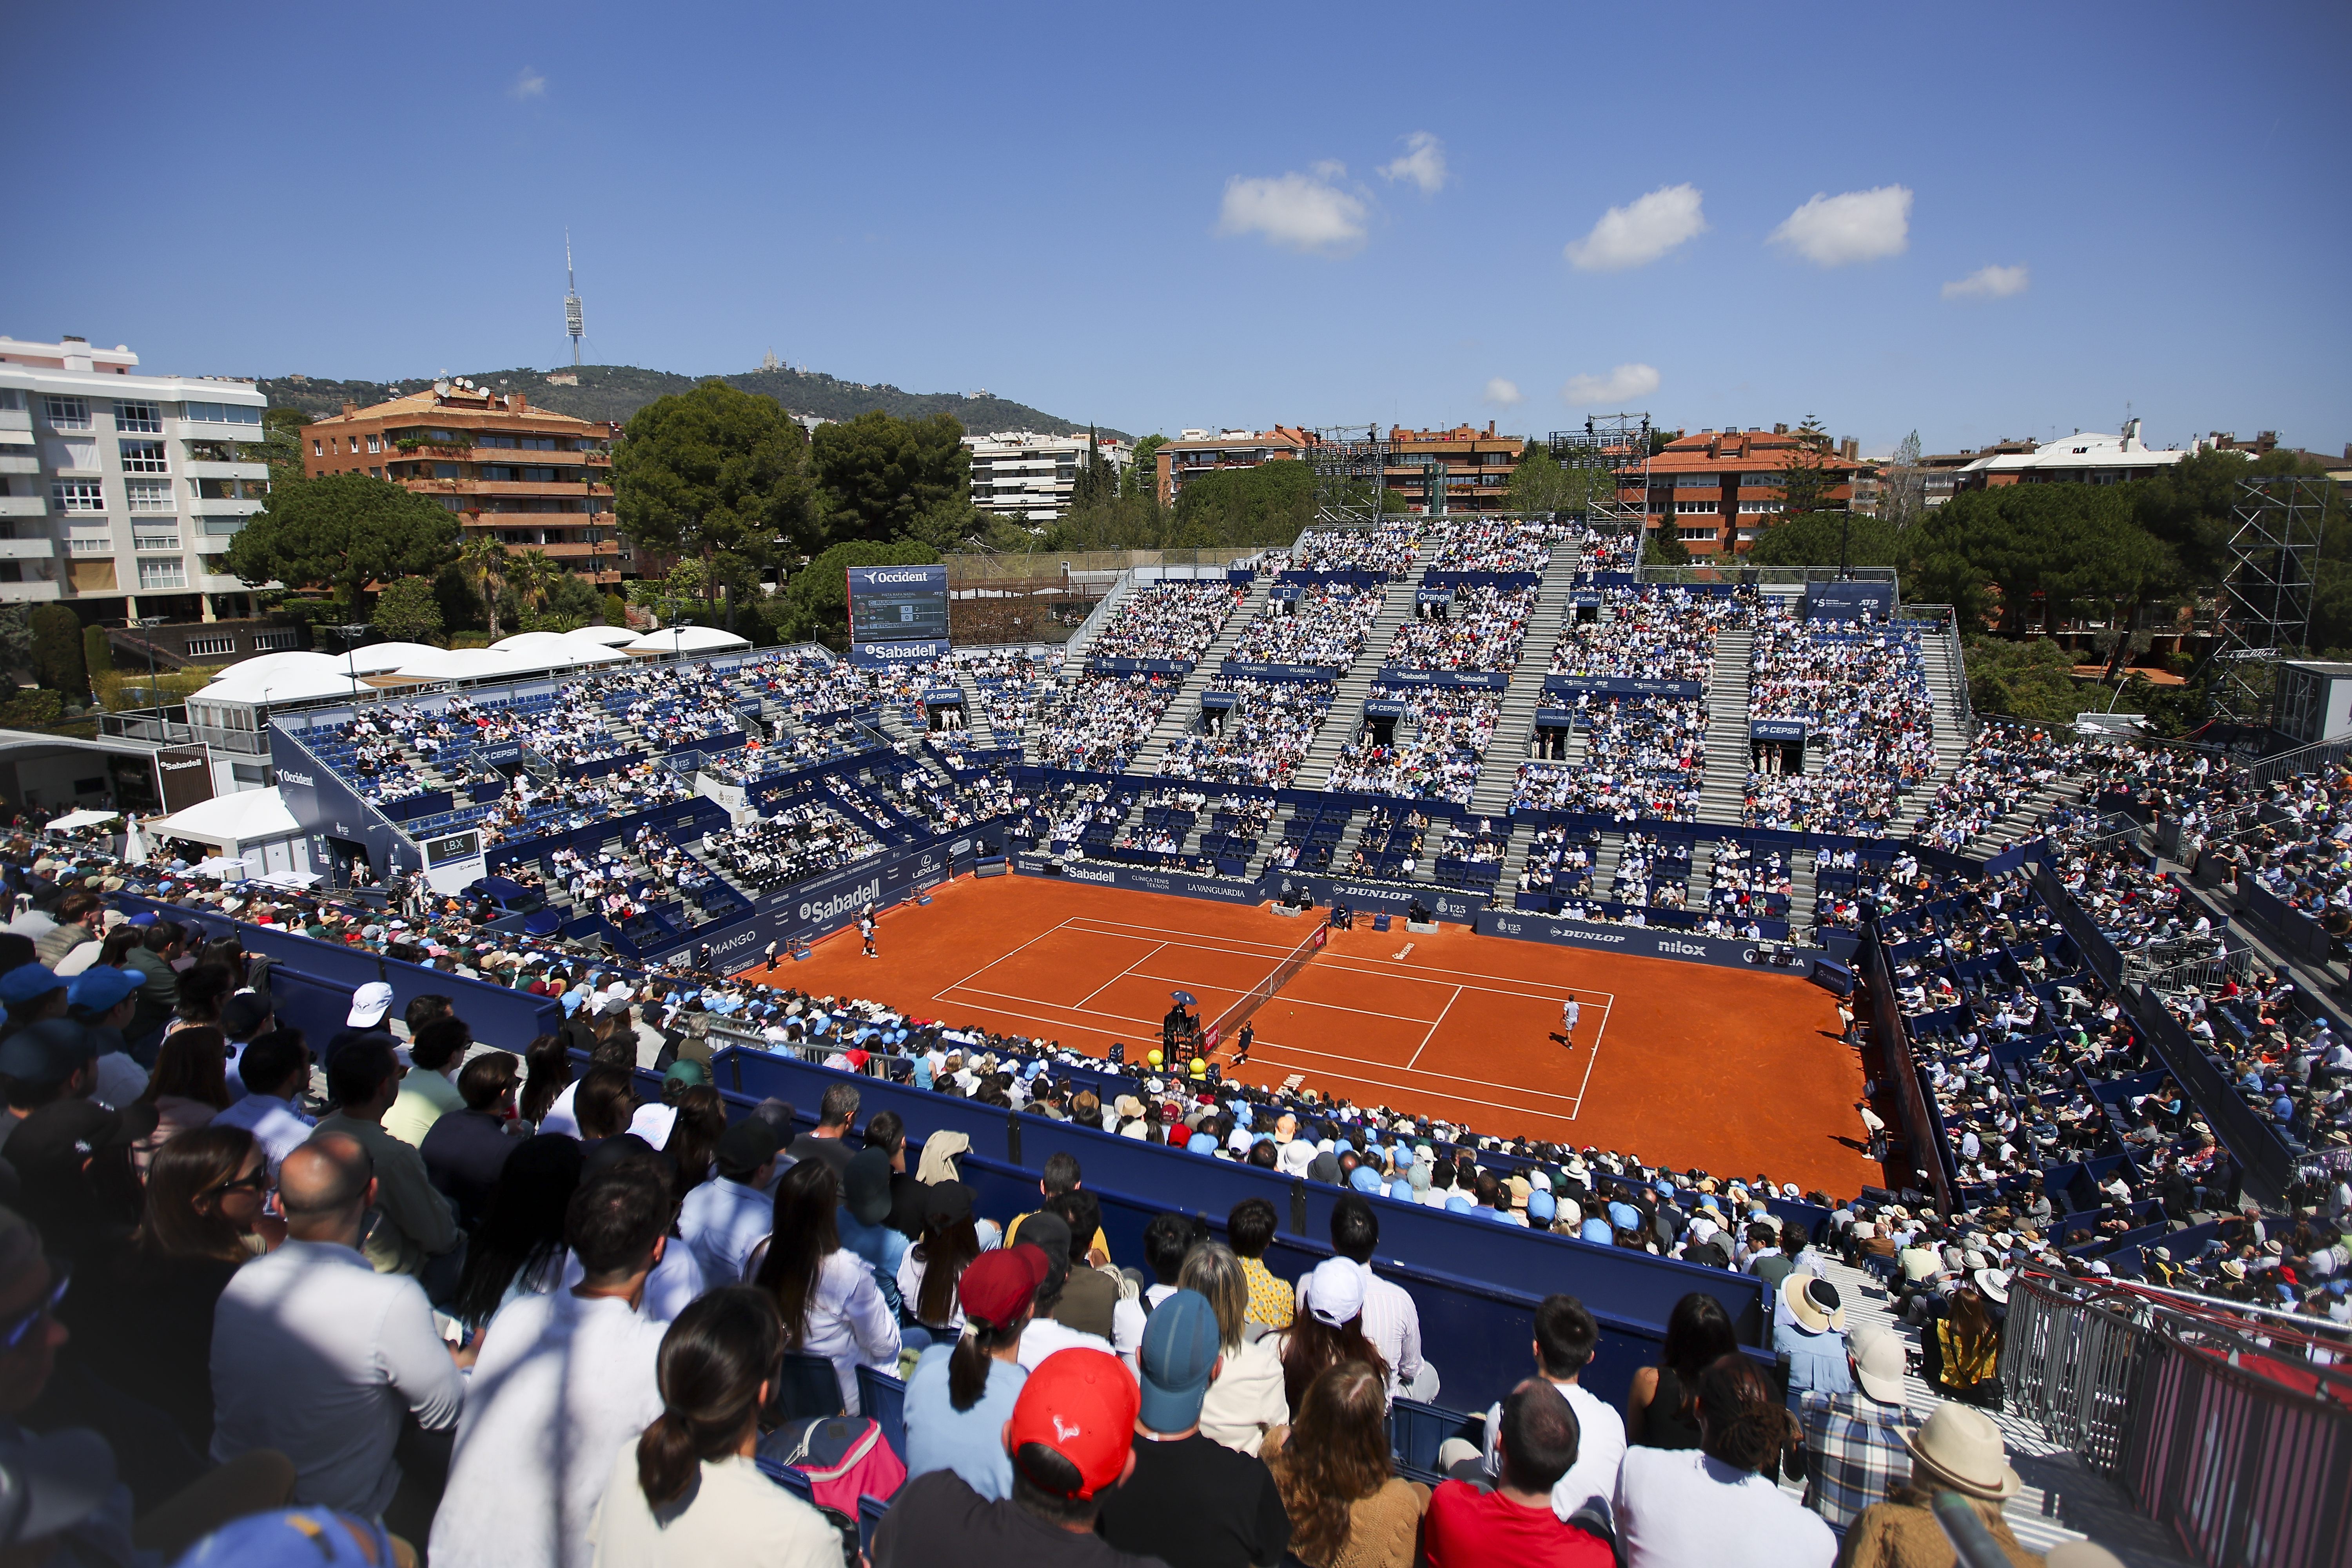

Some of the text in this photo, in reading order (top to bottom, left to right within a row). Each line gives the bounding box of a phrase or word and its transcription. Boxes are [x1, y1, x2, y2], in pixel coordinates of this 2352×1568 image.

[878, 572, 927, 583] Occident
[1419, 592, 1450, 602] Orange
[875, 643, 936, 659] Sabadell
[740, 704, 759, 712] CEPSA
[490, 748, 518, 760] CEPSA
[165, 758, 202, 771] Sabadell
[283, 770, 314, 787] Occident
[443, 838, 464, 851] LBX
[912, 862, 941, 879] LEXUS
[1069, 867, 1115, 882] Sabadell
[923, 877, 940, 889] Occident
[771, 894, 789, 905] BARCELONA
[1345, 886, 1413, 901] DUNLOP
[812, 878, 880, 923] Sabadell
[1450, 904, 1466, 914] 125
[1508, 924, 1521, 932] 125
[1562, 929, 1626, 943] DUNLOP
[710, 930, 756, 957] MANGO
[1658, 940, 1706, 957] nilox
[732, 958, 755, 973] SCORES
[1761, 955, 1805, 967] VEOLIA
